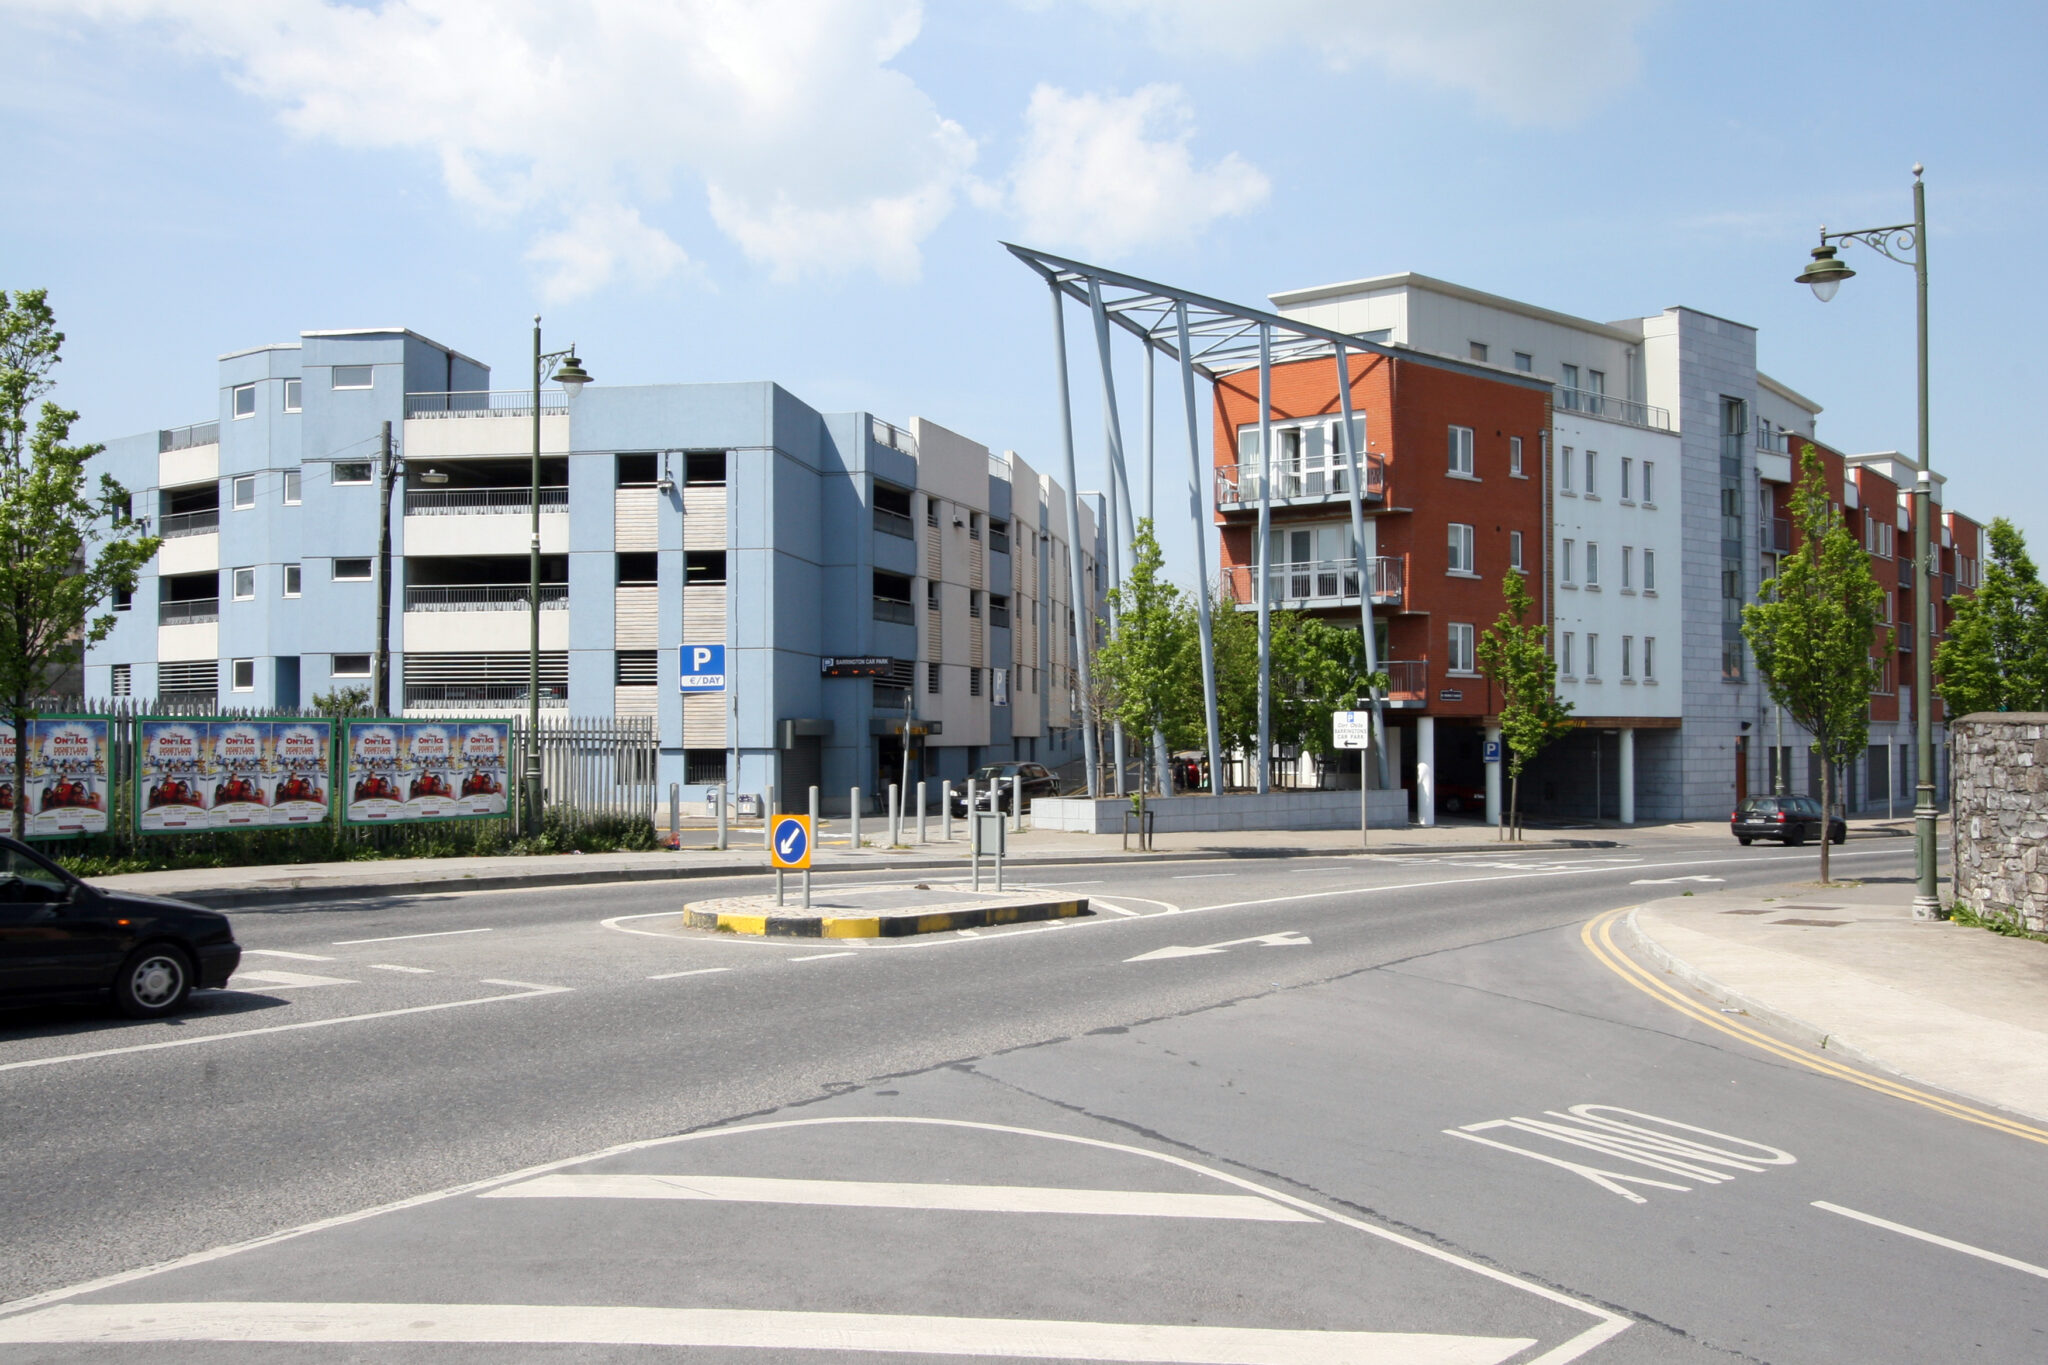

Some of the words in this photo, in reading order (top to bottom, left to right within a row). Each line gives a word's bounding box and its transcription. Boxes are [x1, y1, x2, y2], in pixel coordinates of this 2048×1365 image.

[693, 647, 712, 672] P
[690, 676, 721, 685] €/DAY
[1486, 743, 1497, 755] P
